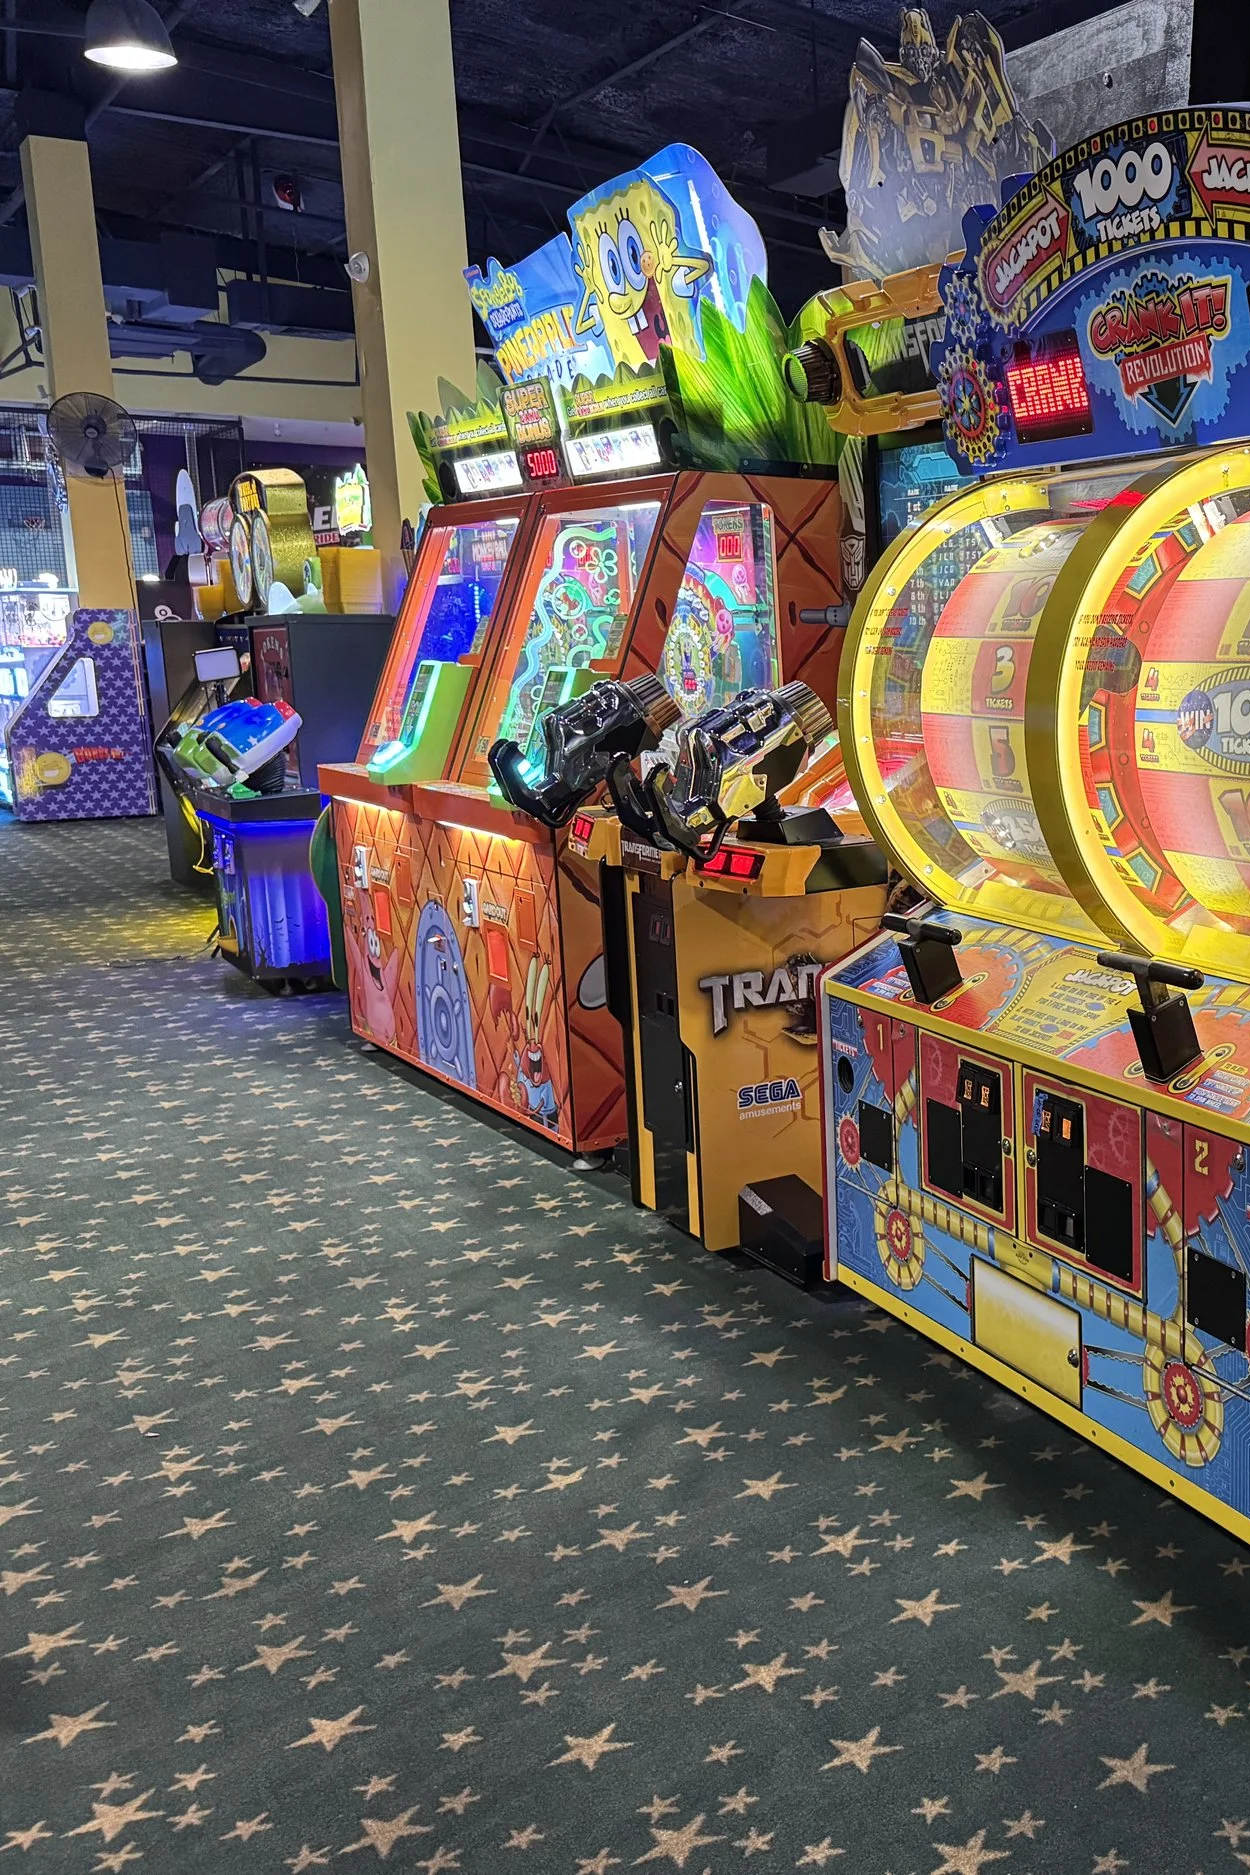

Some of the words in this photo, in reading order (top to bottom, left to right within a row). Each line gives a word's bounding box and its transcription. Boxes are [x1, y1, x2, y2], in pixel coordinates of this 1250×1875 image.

[1073, 142, 1172, 220] 1000
[1096, 203, 1162, 244] TICKETS
[994, 209, 1060, 295] JACKPOT
[1090, 298, 1181, 352] CRANK
[1178, 285, 1227, 336] IT!
[496, 305, 578, 386] PINEAPPLE
[1124, 340, 1206, 385] REVOLUTION
[503, 383, 549, 416] SUPER
[1007, 357, 1088, 417] CRANK
[515, 417, 553, 443] BONUS
[527, 449, 557, 477] 5000
[313, 531, 340, 546] RIDE
[1003, 574, 1056, 619] 10
[991, 645, 1015, 694] 3
[1144, 667, 1161, 692] 4
[985, 697, 1013, 711] TICKETS
[1178, 707, 1214, 737] WIN
[989, 725, 1016, 777] 5
[1142, 728, 1157, 753] 4
[1064, 969, 1138, 996] JACKPOT
[833, 1040, 858, 1057] TICKETS
[877, 1023, 884, 1052] 1
[738, 1078, 803, 1109] SEGA
[739, 1101, 801, 1120] amusements
[1195, 1139, 1209, 1176] 2
